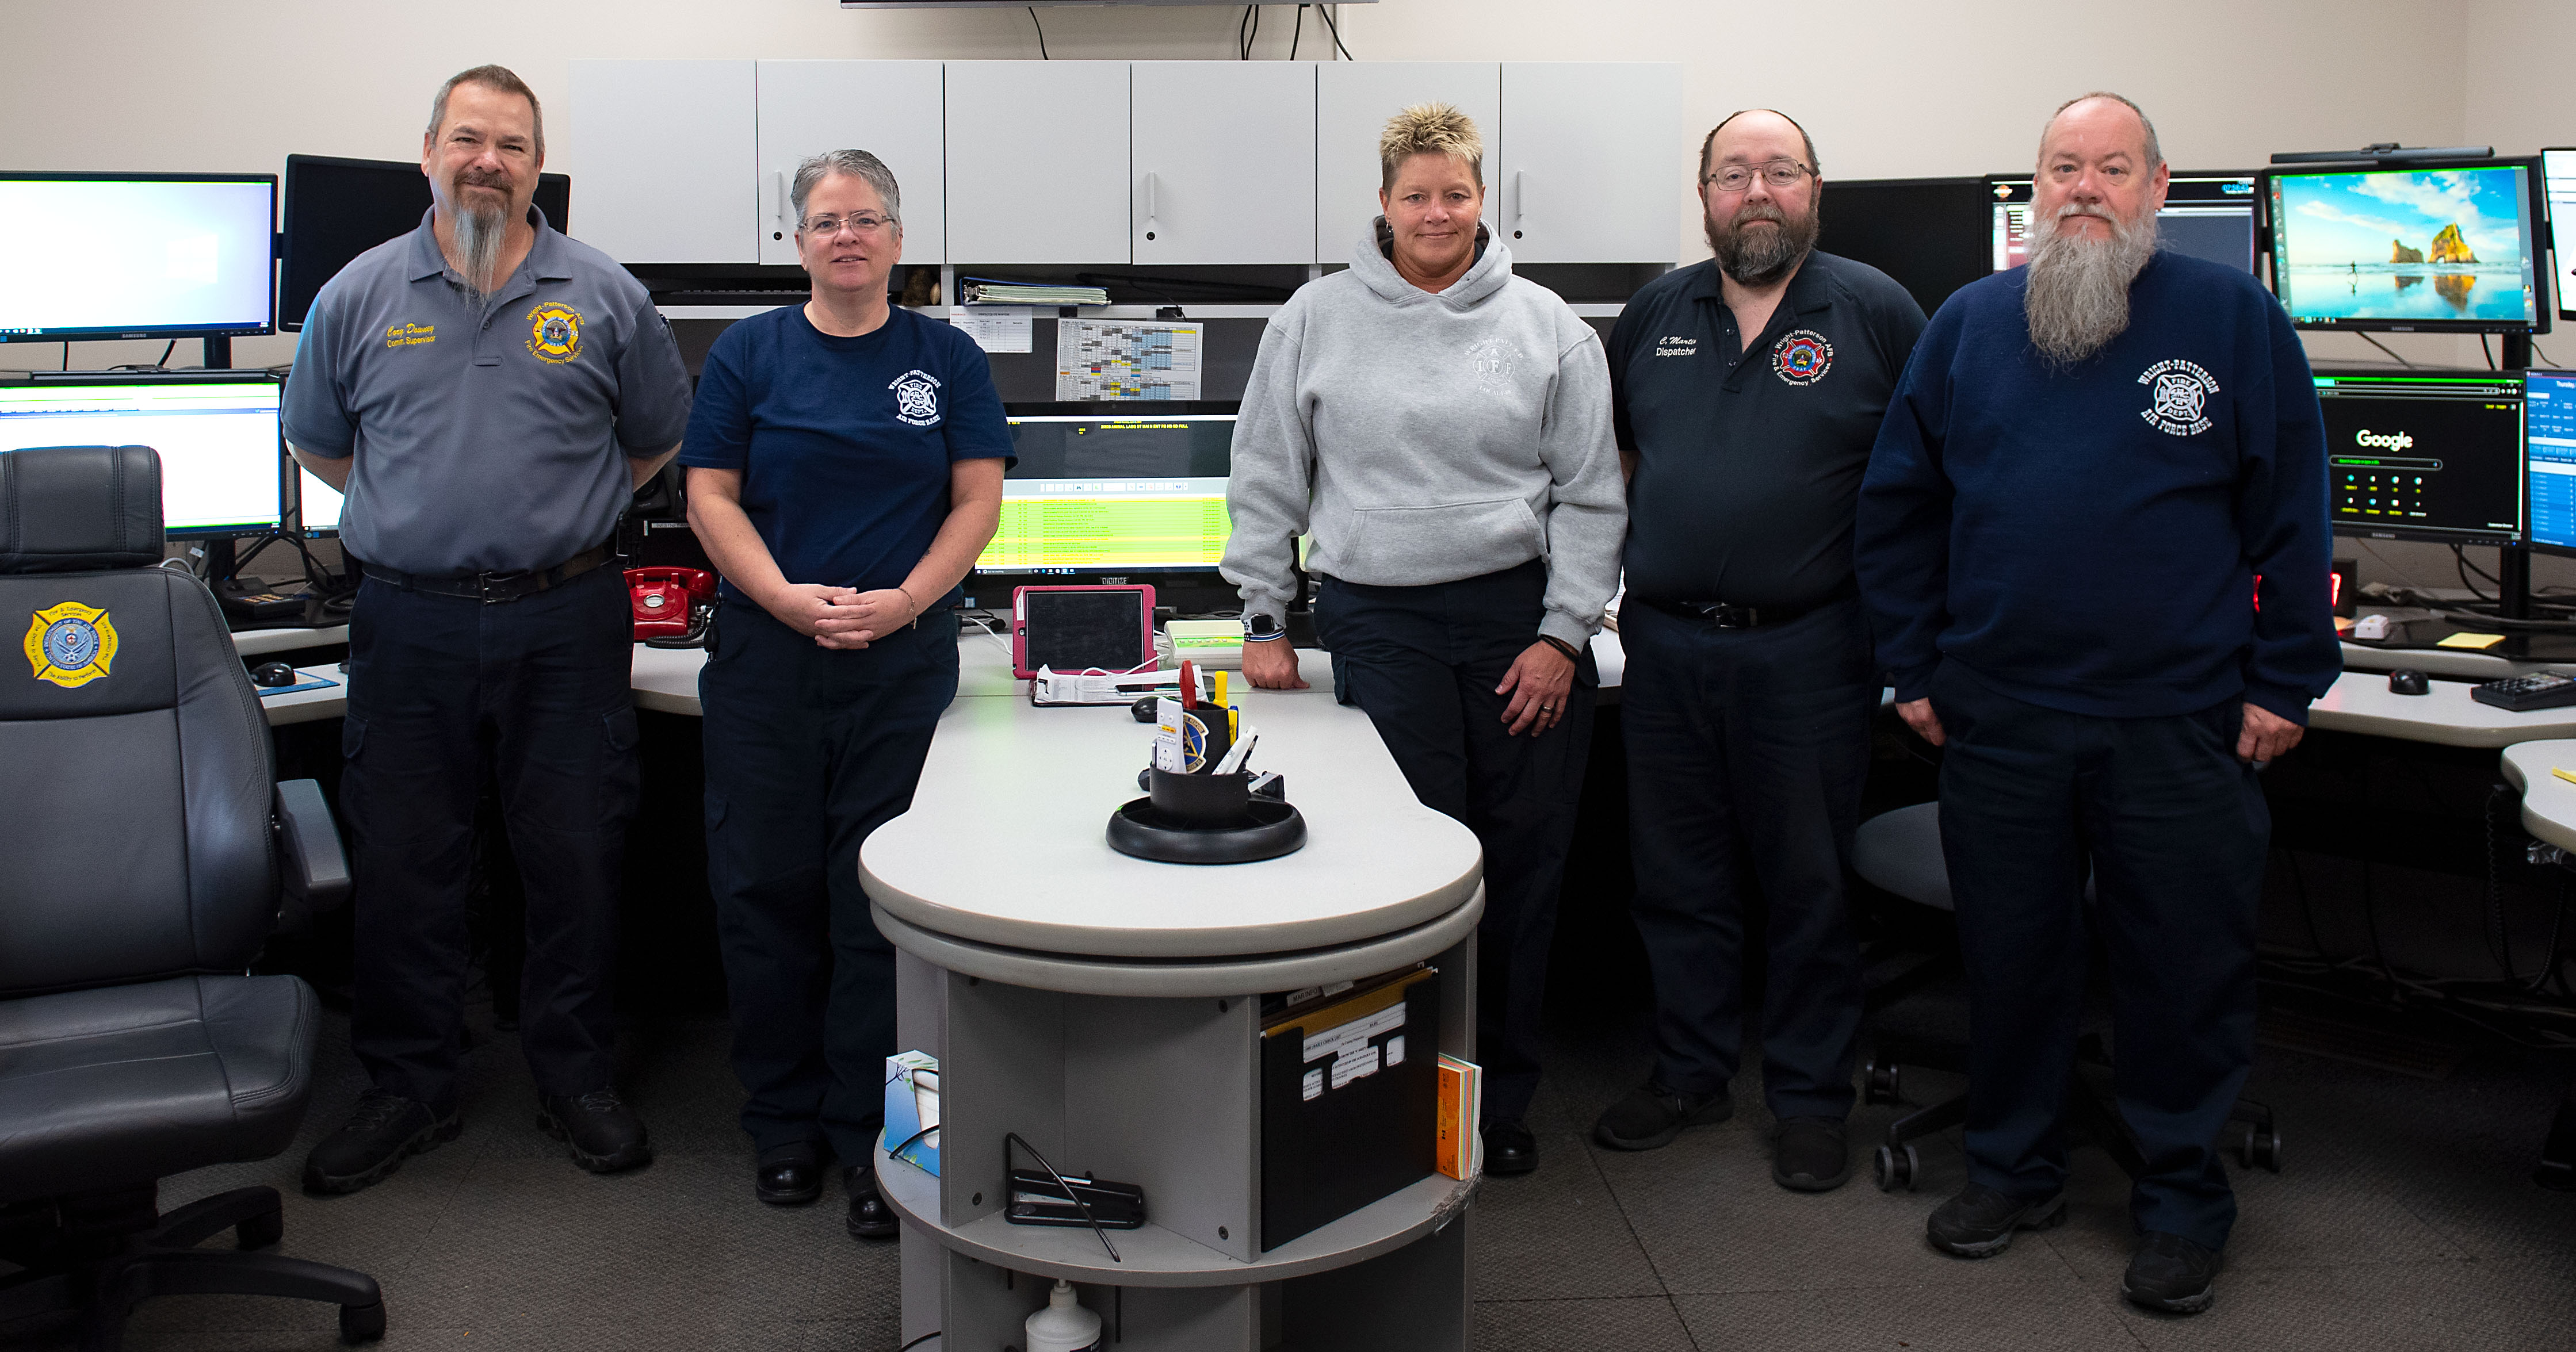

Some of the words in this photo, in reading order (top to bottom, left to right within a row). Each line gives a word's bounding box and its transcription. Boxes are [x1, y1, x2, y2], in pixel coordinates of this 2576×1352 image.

[526, 301, 574, 320] Wright-Patterson
[406, 323, 434, 334] Downey
[406, 335, 435, 345] Supervisor
[1775, 330, 1826, 349] Wright-Patterson
[1825, 344, 1833, 357] AFB
[532, 350, 564, 365] Emergency
[565, 346, 583, 362] Services
[888, 369, 942, 389] WRIGHT-PATTERSON
[1777, 371, 1809, 385] Emergency
[1811, 363, 1830, 382] Services
[2137, 359, 2220, 394] WRIGHT-PATTERSON
[2172, 378, 2191, 386] FIRE
[896, 414, 907, 423] AIR
[926, 414, 941, 426] BASE
[2141, 408, 2160, 426] AIR
[2158, 419, 2187, 436] FORCE
[2189, 416, 2212, 435] BASE
[2356, 429, 2413, 451] Google
